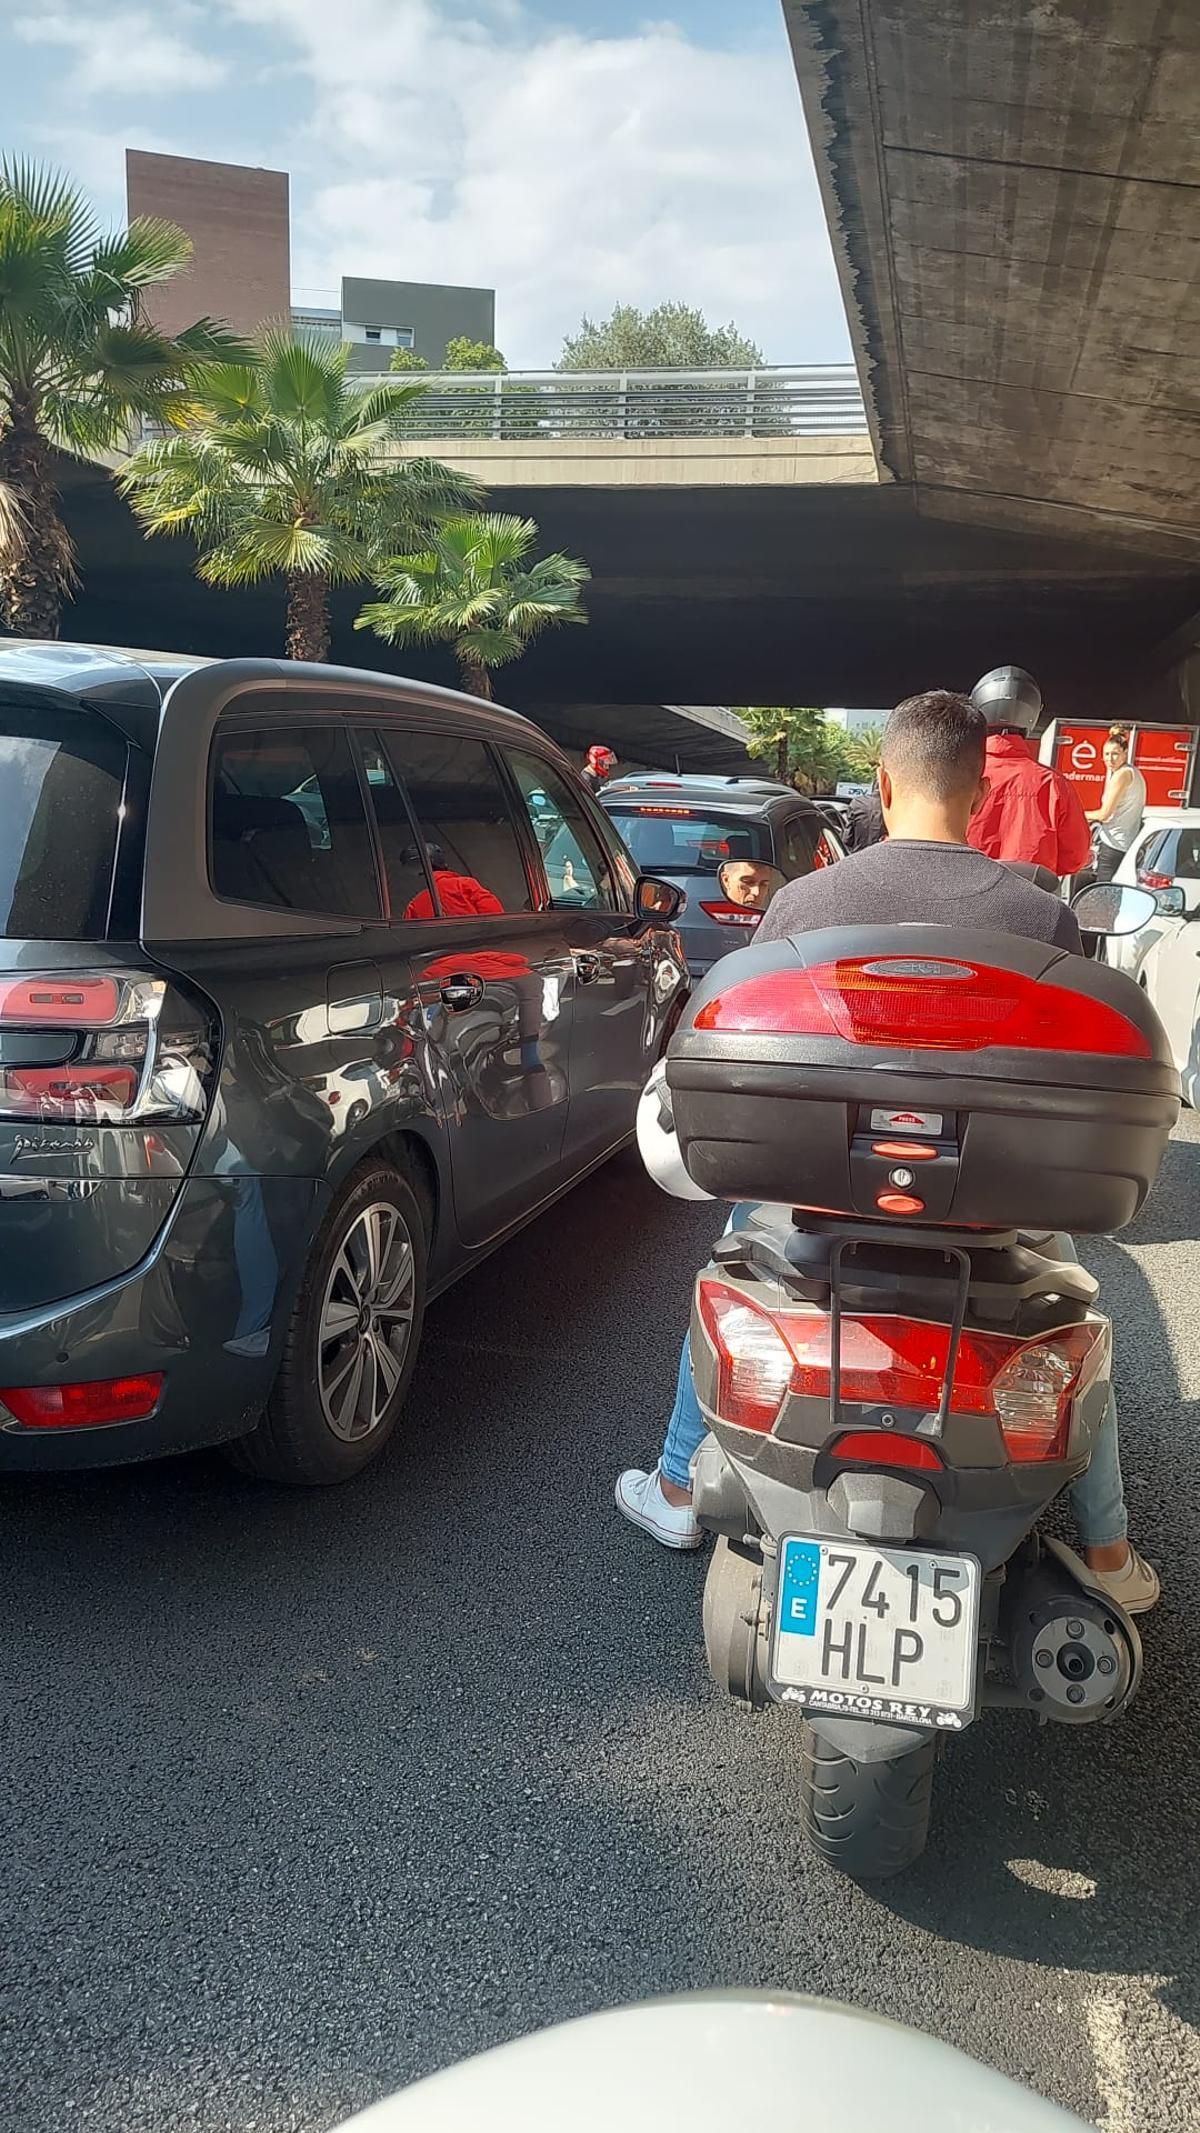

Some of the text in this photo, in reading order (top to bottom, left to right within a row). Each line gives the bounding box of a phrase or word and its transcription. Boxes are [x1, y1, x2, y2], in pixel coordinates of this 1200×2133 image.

[790, 1597, 808, 1619] E
[826, 1554, 963, 1629] 7415
[821, 1618, 925, 1687] HLP
[809, 1690, 931, 1718] MOTOS REY
